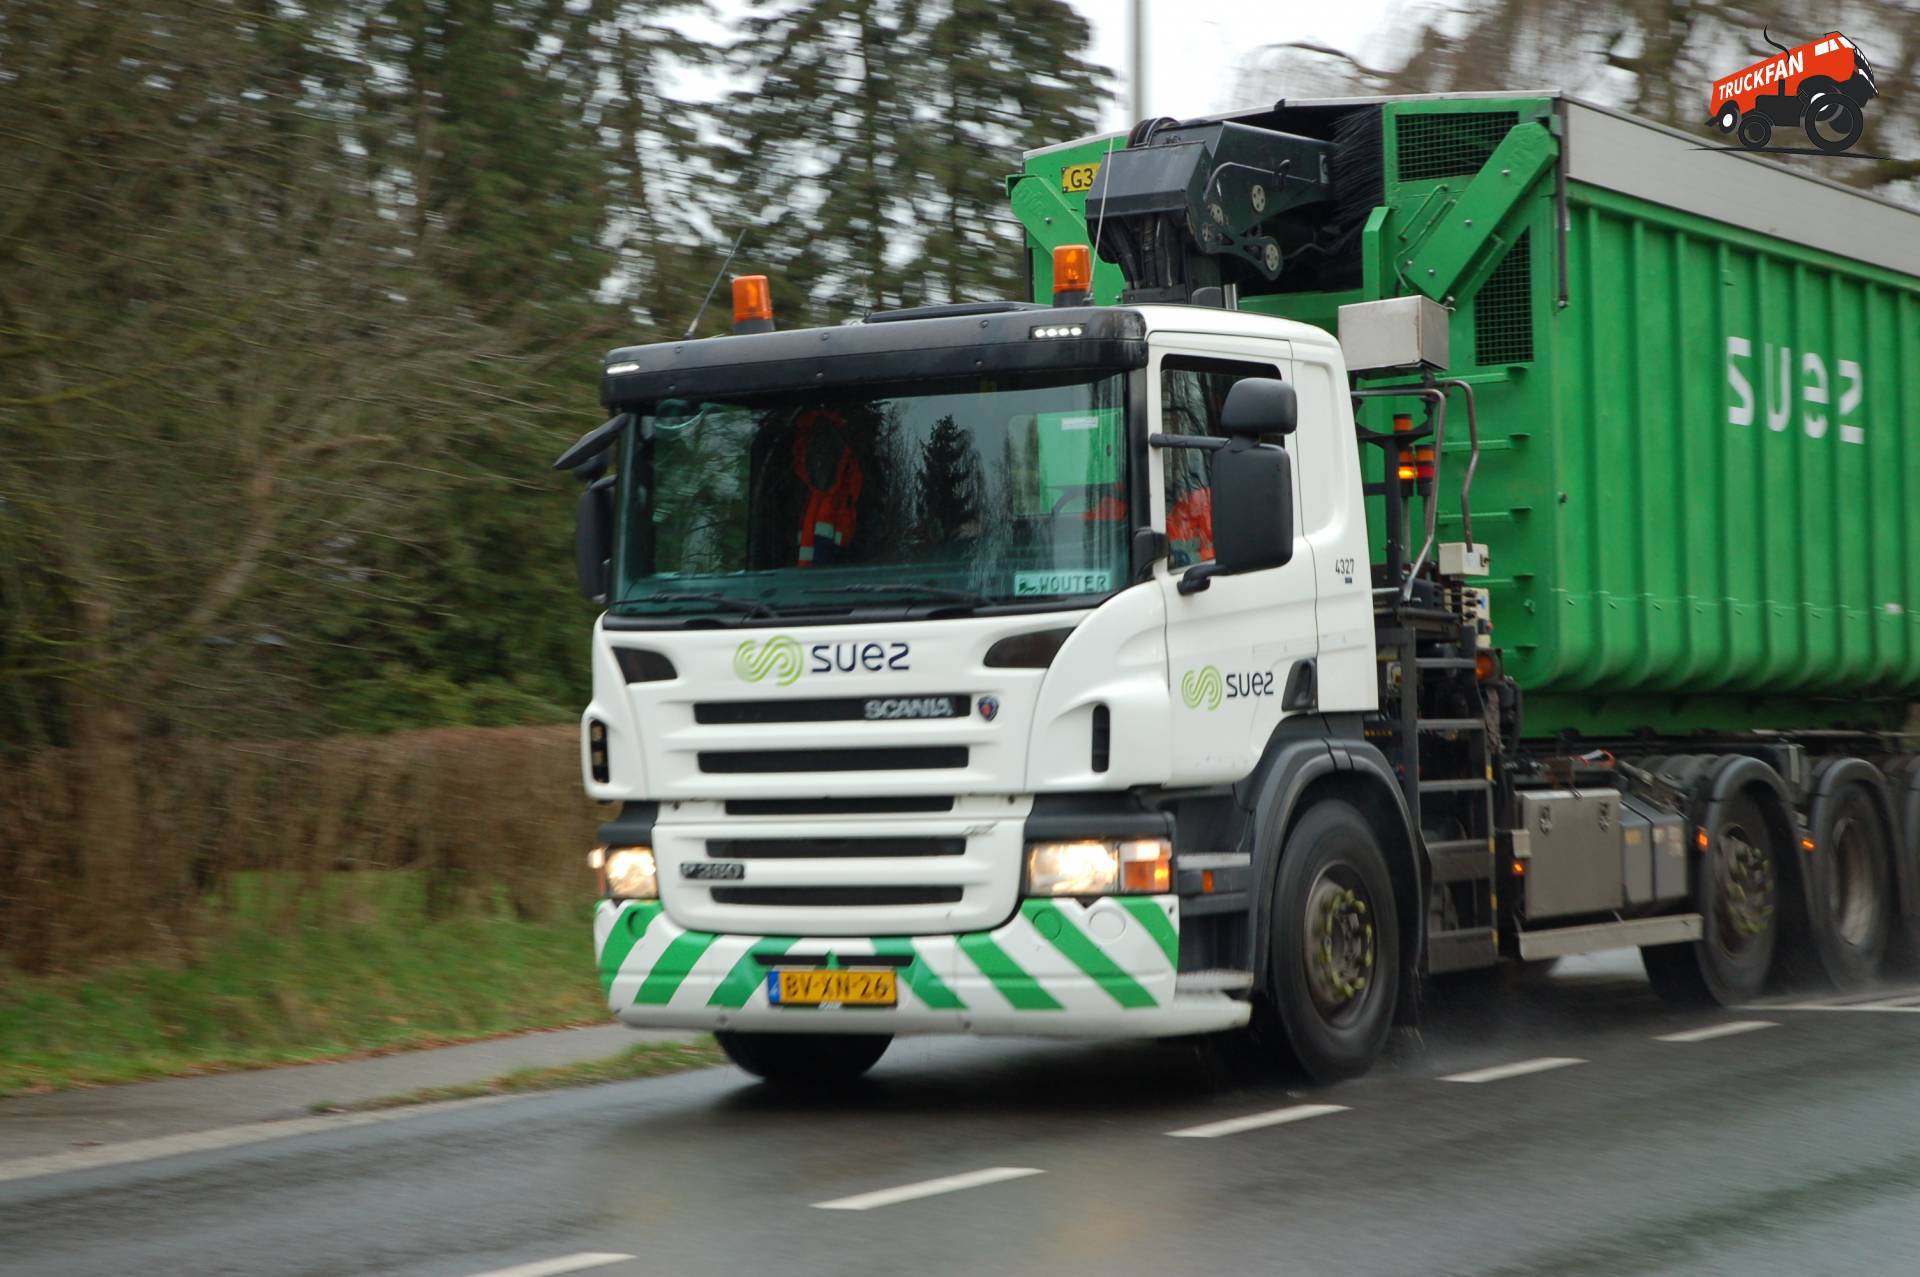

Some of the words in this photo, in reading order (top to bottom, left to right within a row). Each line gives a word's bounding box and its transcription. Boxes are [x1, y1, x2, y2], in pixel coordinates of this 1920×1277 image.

[1726, 336, 1865, 445] suez
[1335, 558, 1355, 575] 4327
[1040, 575, 1107, 593] WOUTER
[811, 642, 910, 673] suez
[1226, 671, 1274, 698] suez
[864, 697, 954, 719] SCANIA
[785, 973, 888, 1000] BV-XN-26
